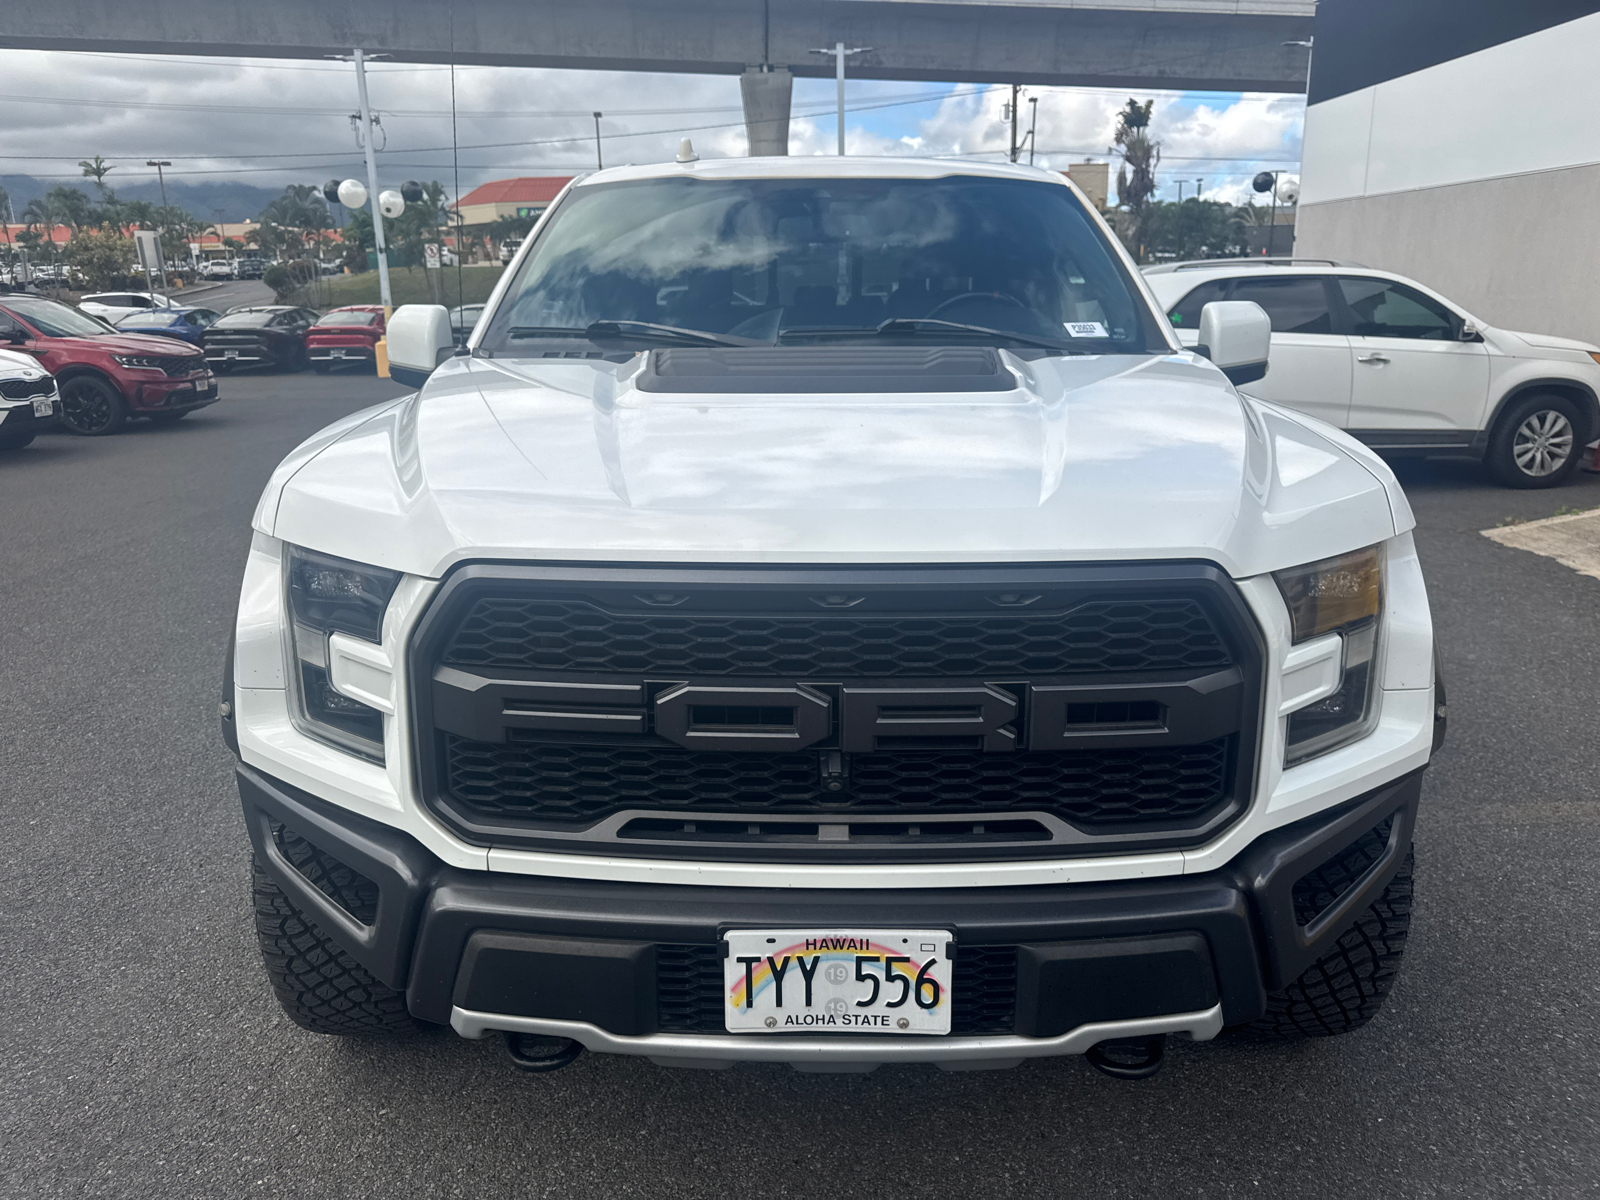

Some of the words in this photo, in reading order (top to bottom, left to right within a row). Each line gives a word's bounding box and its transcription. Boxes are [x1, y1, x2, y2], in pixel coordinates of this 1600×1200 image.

[434, 665, 1241, 753] FORD
[805, 938, 870, 951] HAWAII
[827, 968, 846, 980] 19
[736, 955, 821, 1009] TYY
[855, 955, 940, 1009] 556
[784, 1014, 836, 1026] ALOHA
[841, 1014, 890, 1026] STATE
